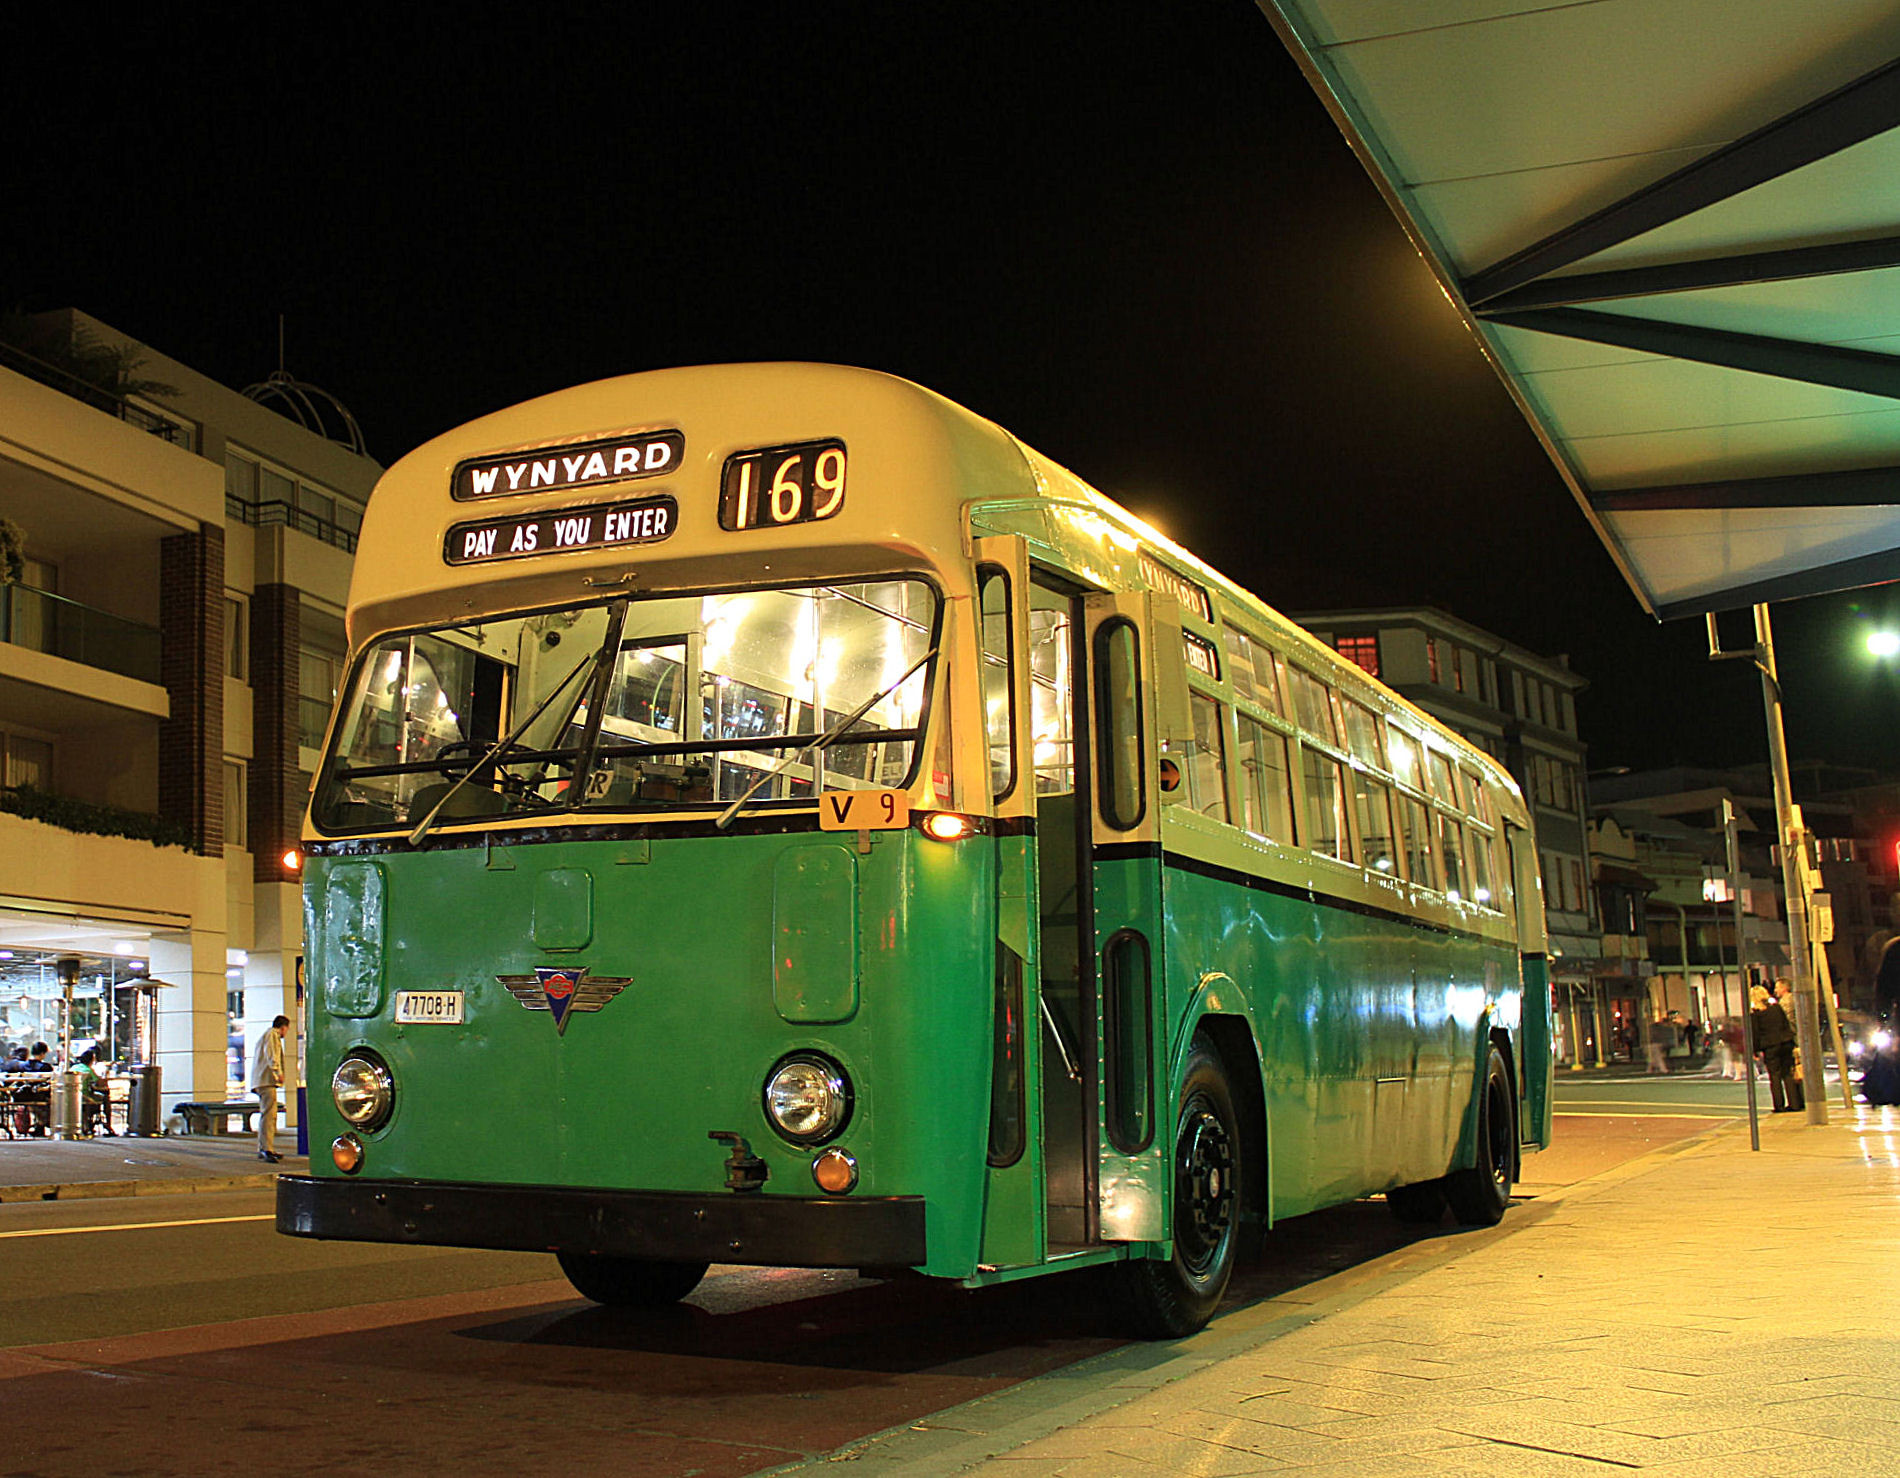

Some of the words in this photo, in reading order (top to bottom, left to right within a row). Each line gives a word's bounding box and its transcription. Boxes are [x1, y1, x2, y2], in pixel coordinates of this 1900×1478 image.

[472, 442, 671, 494] WYNYARD
[737, 448, 846, 529] 169
[463, 529, 498, 559] PAY
[510, 524, 539, 553] AS
[554, 517, 592, 547] YOU
[604, 507, 668, 542] ENTER
[830, 796, 854, 824] V
[880, 793, 895, 824] 9
